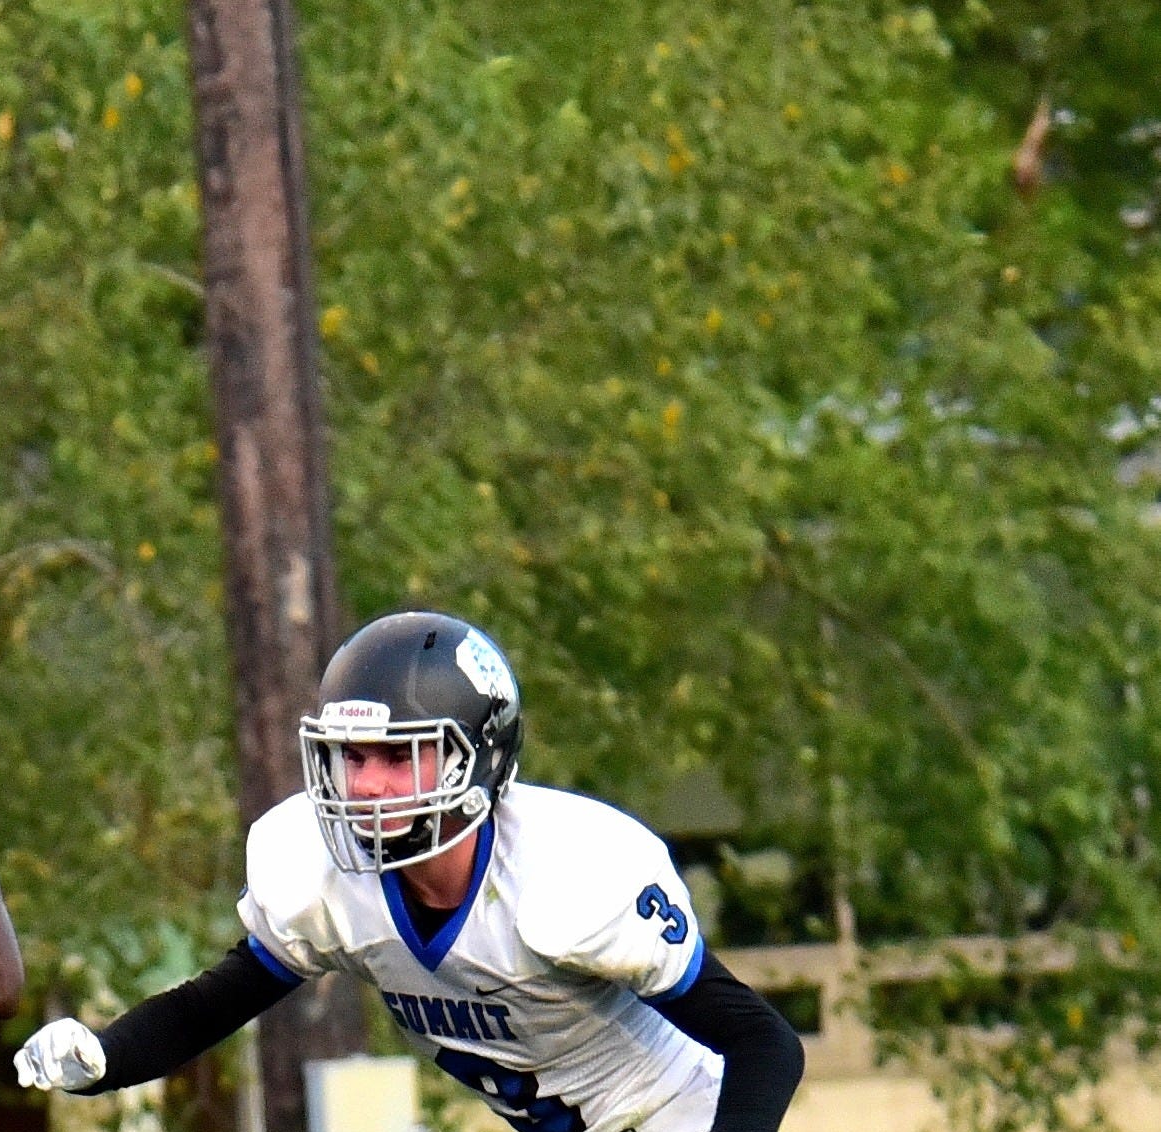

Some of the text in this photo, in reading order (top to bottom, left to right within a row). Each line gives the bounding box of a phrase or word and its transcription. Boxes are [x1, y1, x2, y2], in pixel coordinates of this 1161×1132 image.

[339, 705, 373, 717] Riddell
[636, 882, 688, 945] 3
[381, 990, 519, 1041] SUMMIT
